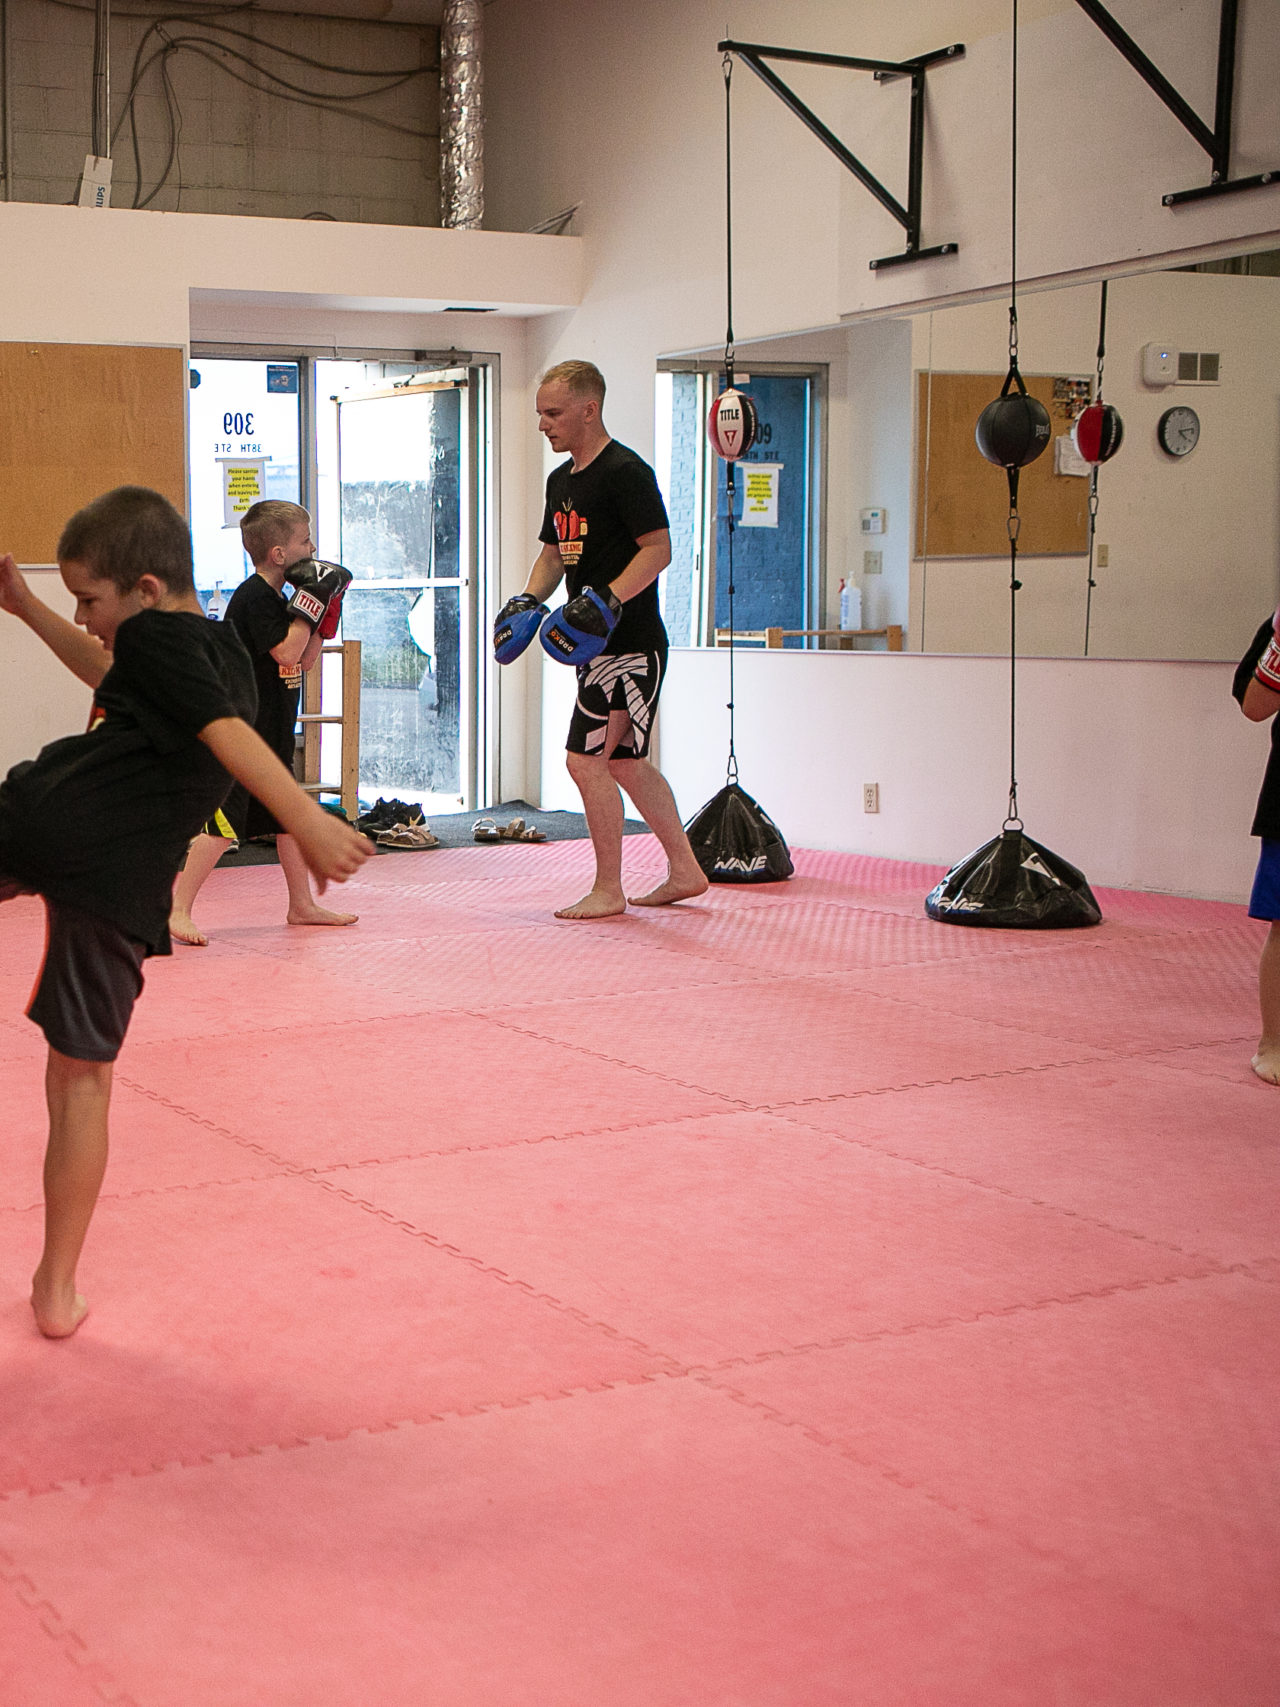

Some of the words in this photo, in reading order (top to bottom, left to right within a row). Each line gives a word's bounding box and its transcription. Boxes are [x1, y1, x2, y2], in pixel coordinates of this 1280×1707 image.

[720, 408, 740, 421] TITLE
[755, 423, 772, 444] 09
[298, 594, 321, 617] TITLE
[550, 630, 574, 652] DRAKO
[714, 856, 767, 872] WAVE
